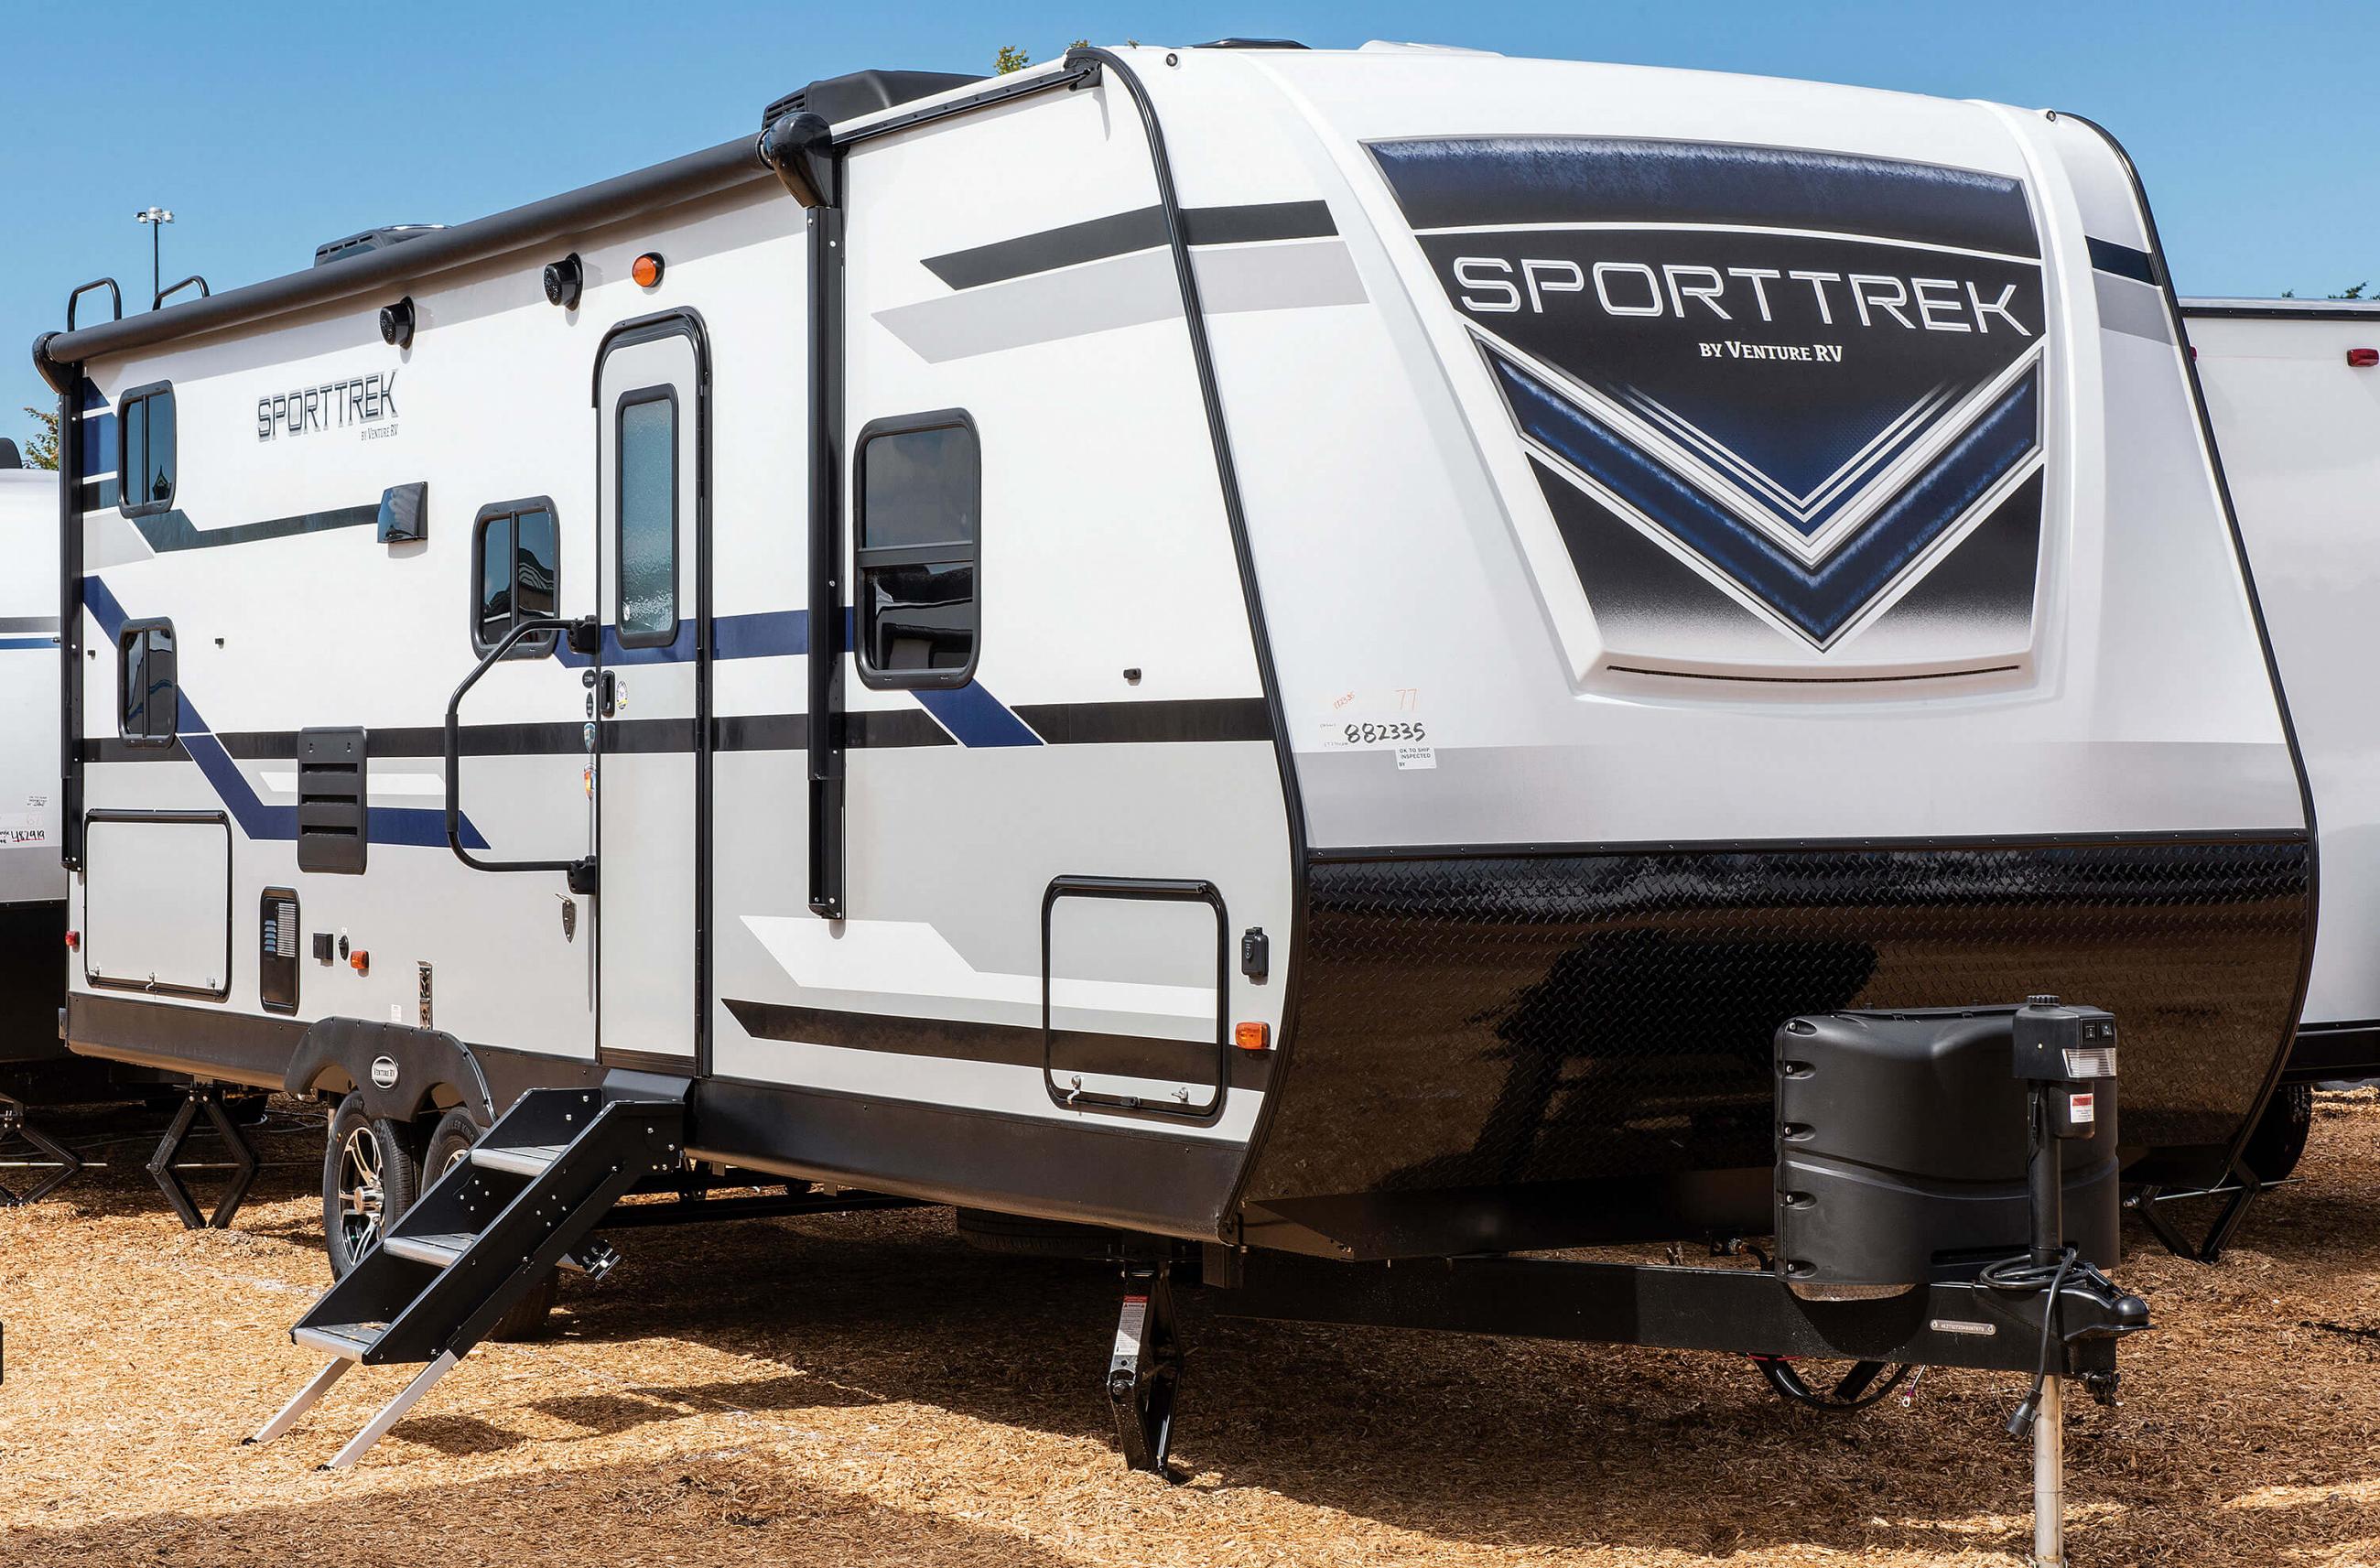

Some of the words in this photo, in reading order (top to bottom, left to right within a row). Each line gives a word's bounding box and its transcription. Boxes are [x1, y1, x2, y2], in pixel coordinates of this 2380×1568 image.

[1453, 257, 2031, 336] SPORTTREK
[1699, 342, 1723, 358] BY
[1725, 341, 1812, 362] VENTURE
[1813, 344, 1843, 362] RV
[258, 370, 398, 441] SPORTTREK
[391, 424, 398, 437] RV
[1396, 688, 1418, 710] 77
[1344, 722, 1426, 743] 882335
